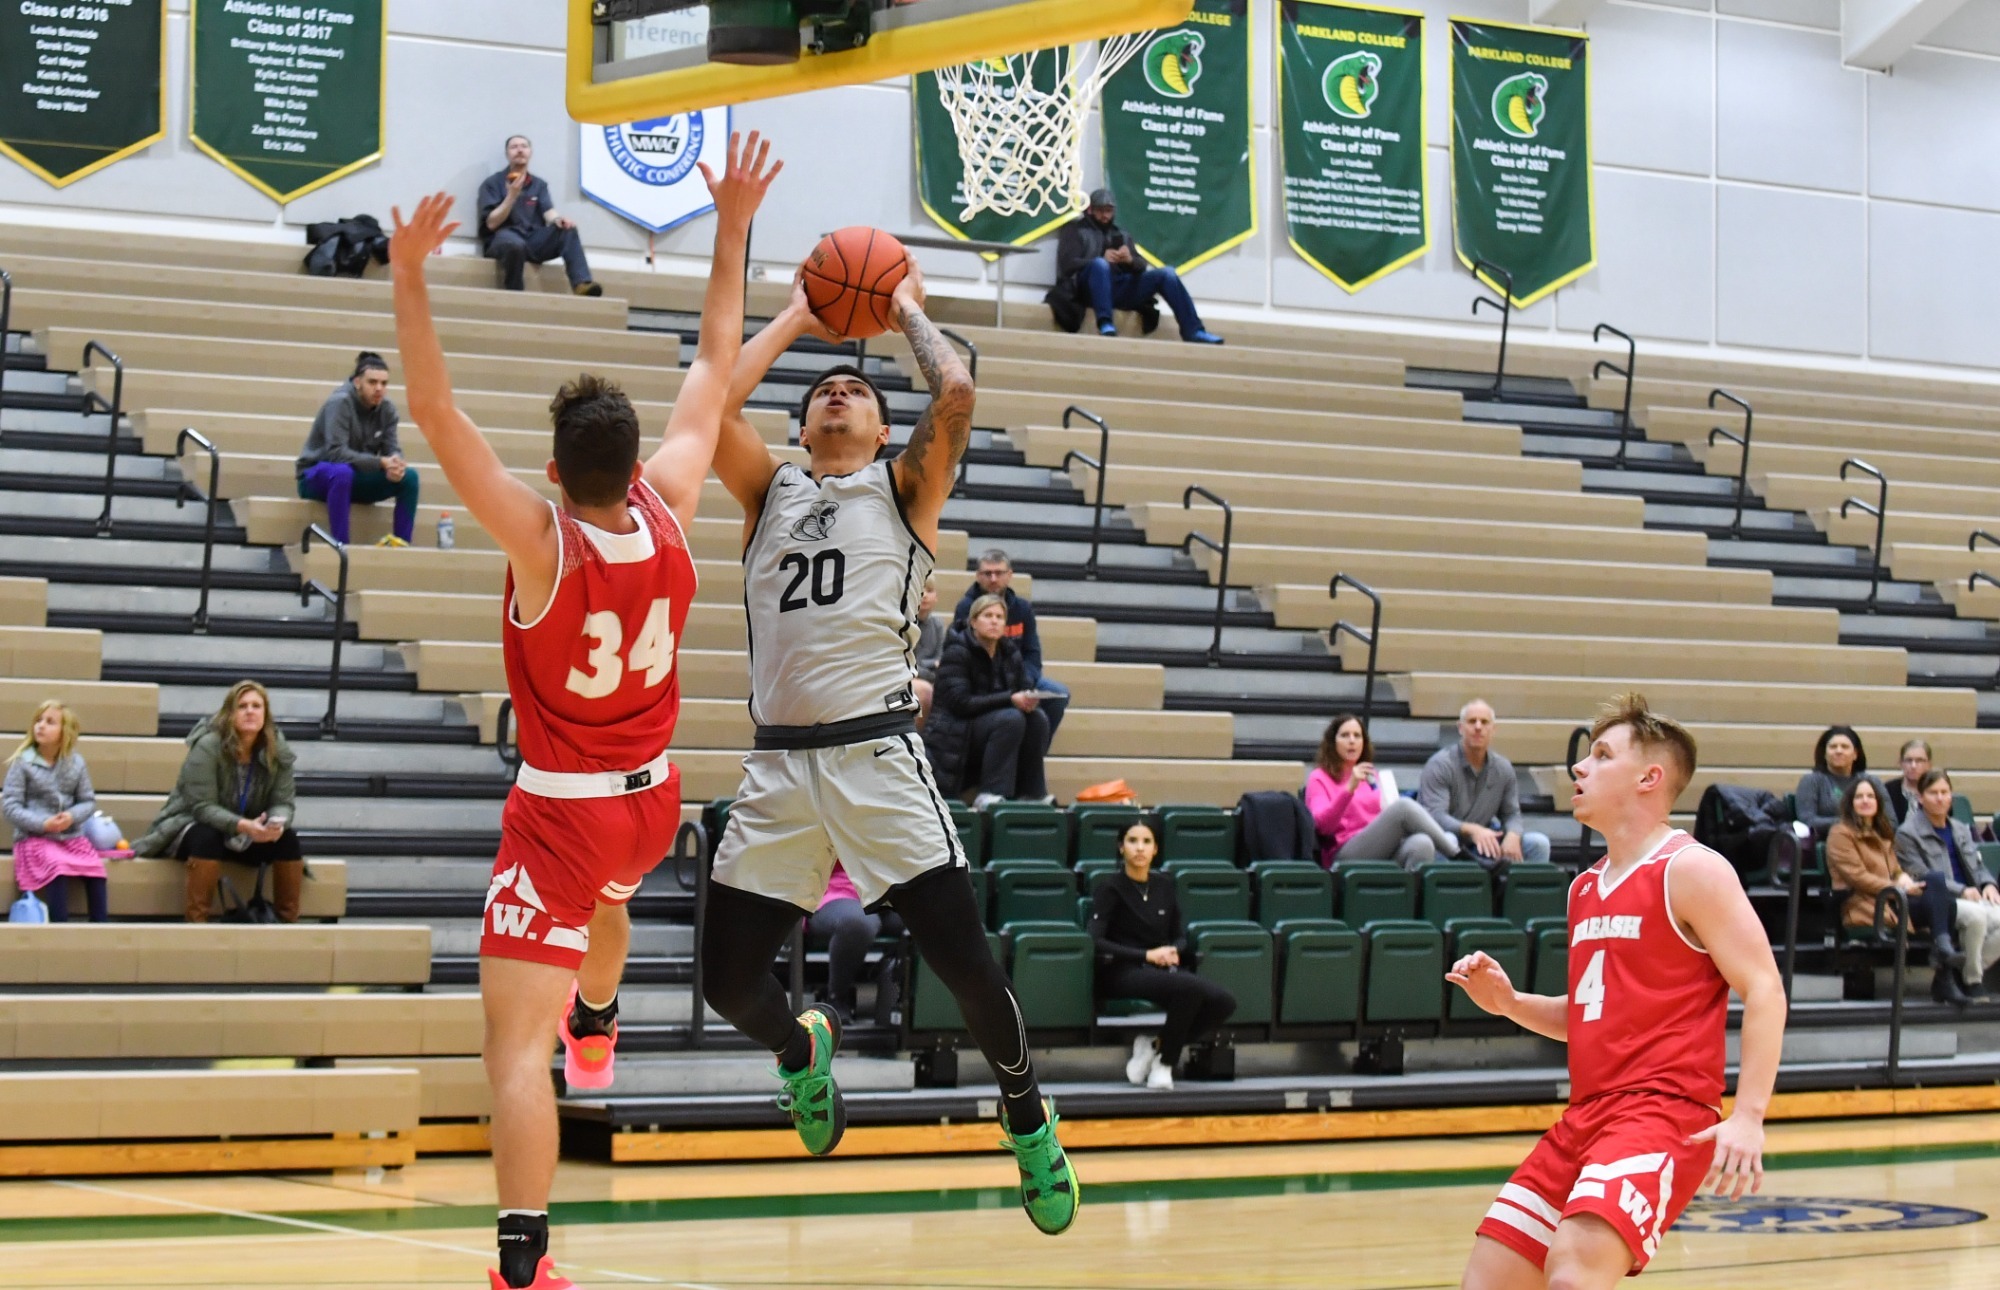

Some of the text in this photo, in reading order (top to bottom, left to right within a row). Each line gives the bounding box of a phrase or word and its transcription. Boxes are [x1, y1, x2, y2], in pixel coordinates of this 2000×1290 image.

[20, 1, 109, 22] Class of 2016
[223, 0, 354, 24] Athletic Hall of Fame
[247, 19, 333, 40] Class of 2017
[626, 21, 705, 45] nferenc
[1296, 24, 1406, 49] PARKLAND COLLEGE
[1468, 46, 1572, 70] PARKLAND COLLEGE
[1121, 100, 1225, 122] Athletic Hall of Fame
[1141, 118, 1206, 136] Class of 2019
[1302, 120, 1400, 142] Athletic Hall of Fame
[606, 126, 646, 178] THLETIC
[631, 136, 677, 152] MWAC
[1321, 138, 1382, 156] Class of 2021
[1473, 138, 1566, 160] Athletic Hall of Fame
[1490, 154, 1550, 172] Class of 2022
[779, 548, 845, 613] 20
[565, 598, 674, 699] 34
[492, 902, 537, 940] W.
[1574, 950, 1605, 1022] 4
